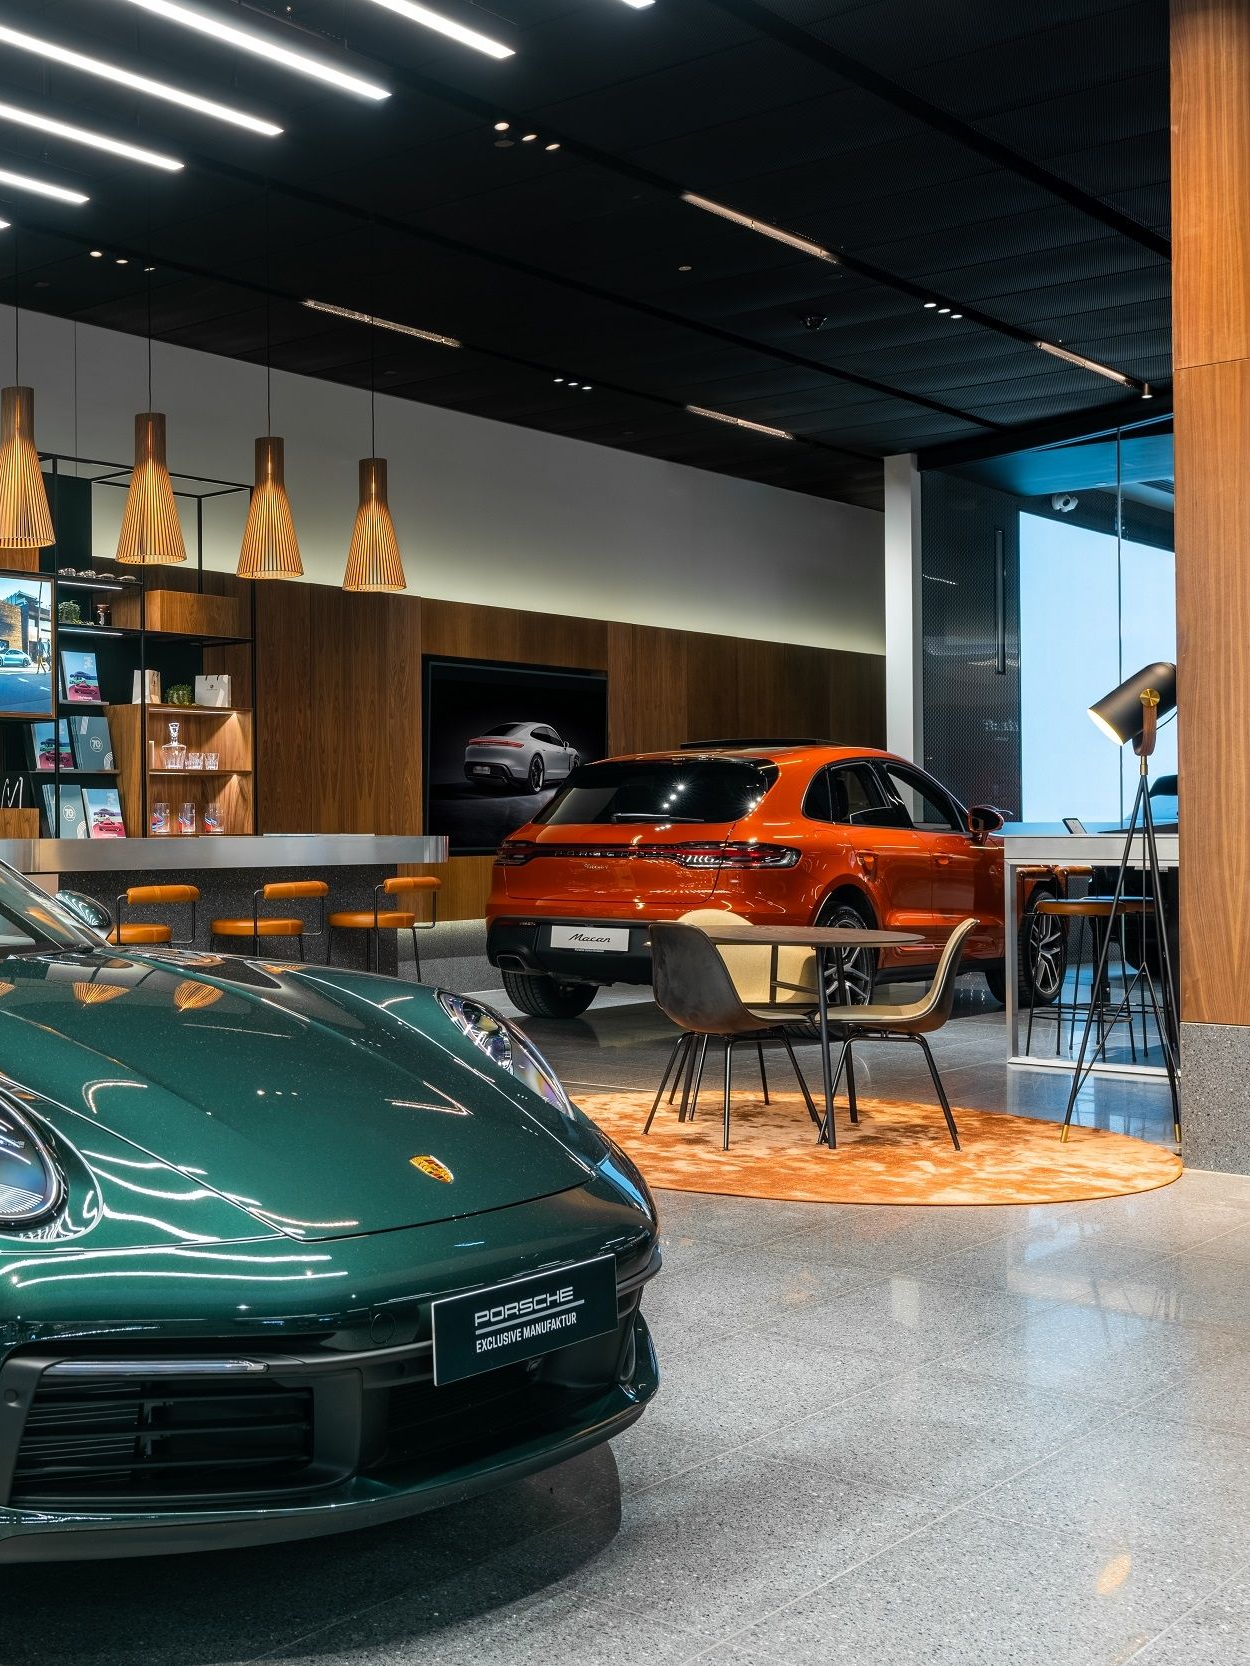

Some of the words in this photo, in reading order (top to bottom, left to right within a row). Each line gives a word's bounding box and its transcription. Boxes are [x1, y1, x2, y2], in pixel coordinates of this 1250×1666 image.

[568, 933, 611, 943] Macan
[474, 1286, 574, 1327] PORSCHE
[476, 1328, 522, 1353] EXCLUSIVE
[523, 1312, 577, 1340] MANUFAKTUR
